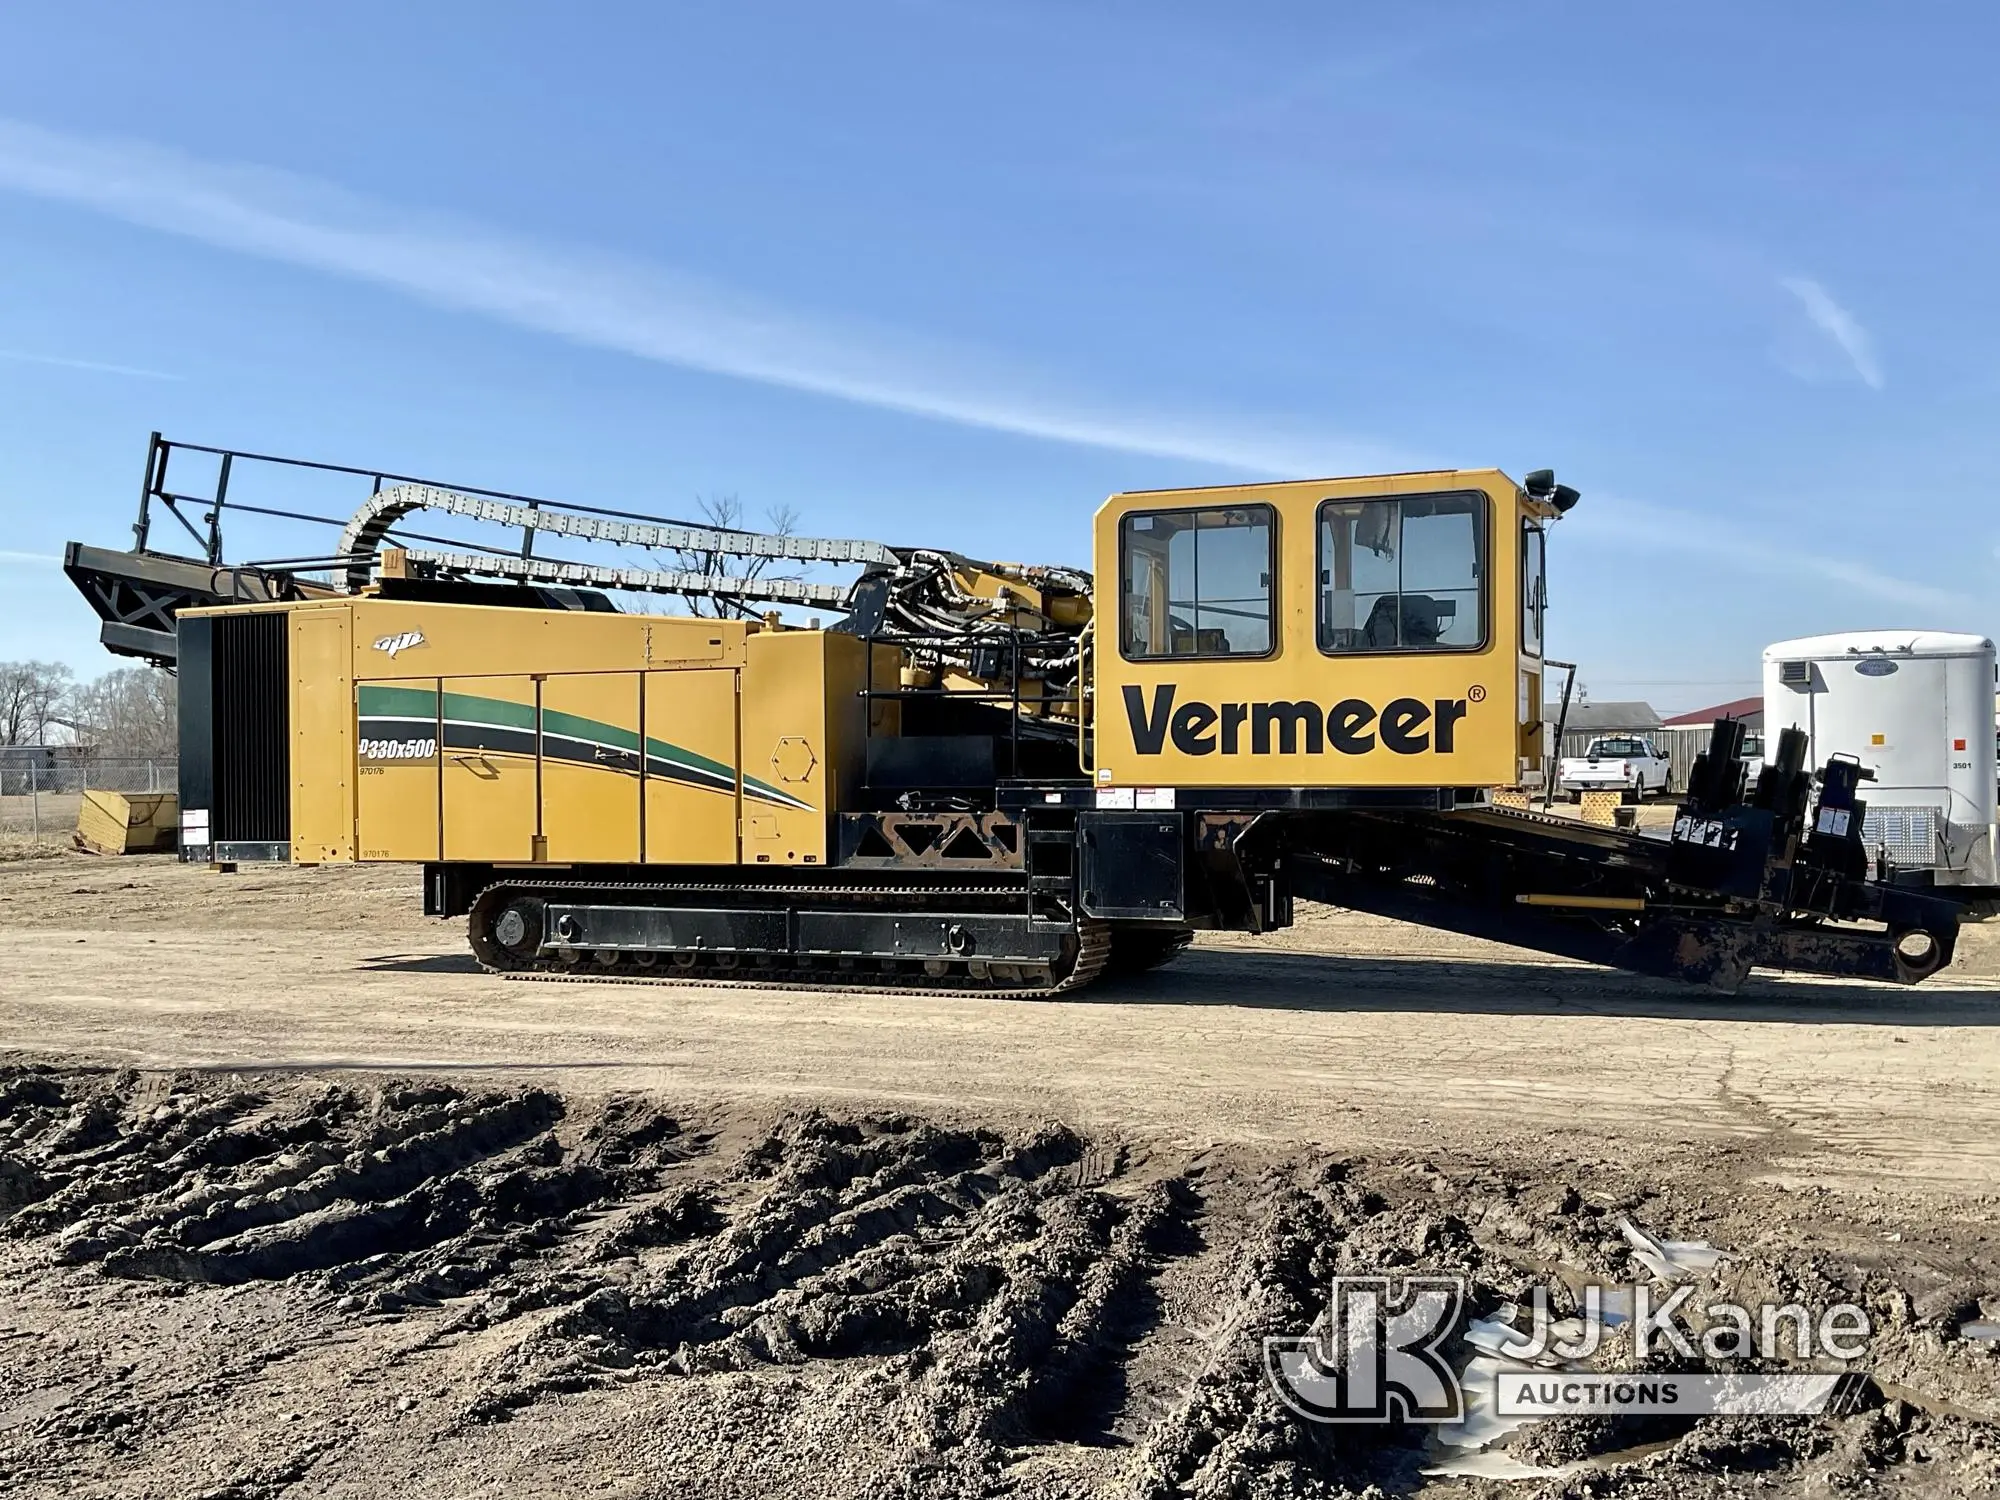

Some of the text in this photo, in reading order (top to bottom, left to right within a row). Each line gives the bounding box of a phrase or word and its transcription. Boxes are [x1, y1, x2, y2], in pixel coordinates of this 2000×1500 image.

[359, 738, 436, 759] D330x500
[1953, 762, 1972, 770] 3501
[360, 767, 385, 775] 970176
[363, 850, 390, 858] 970176
